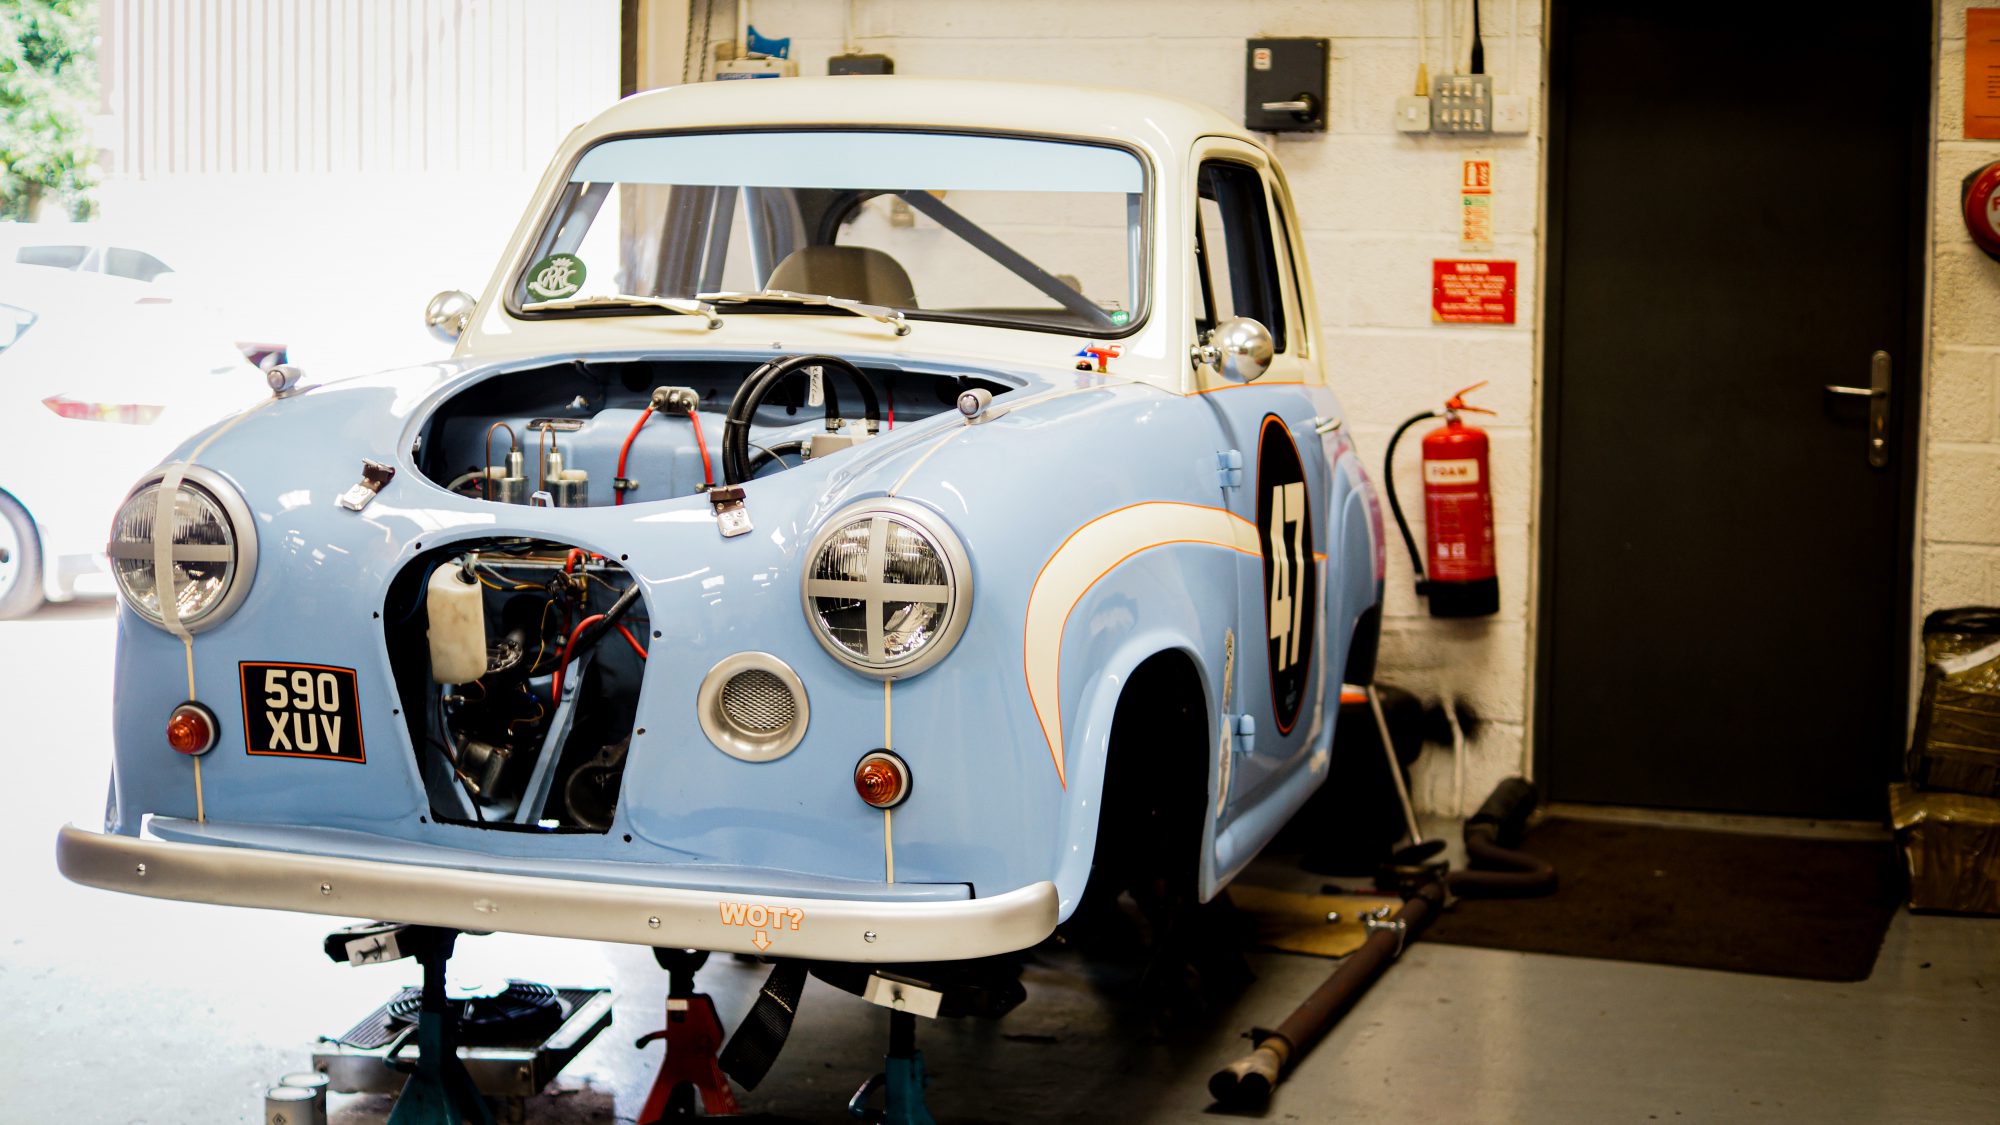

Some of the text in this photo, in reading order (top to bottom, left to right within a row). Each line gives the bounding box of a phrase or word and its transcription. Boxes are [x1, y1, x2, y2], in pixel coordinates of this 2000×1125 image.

[1270, 482, 1304, 672] 47
[265, 669, 339, 712] 590
[266, 711, 341, 753] XUV
[720, 902, 804, 930] WOT?
